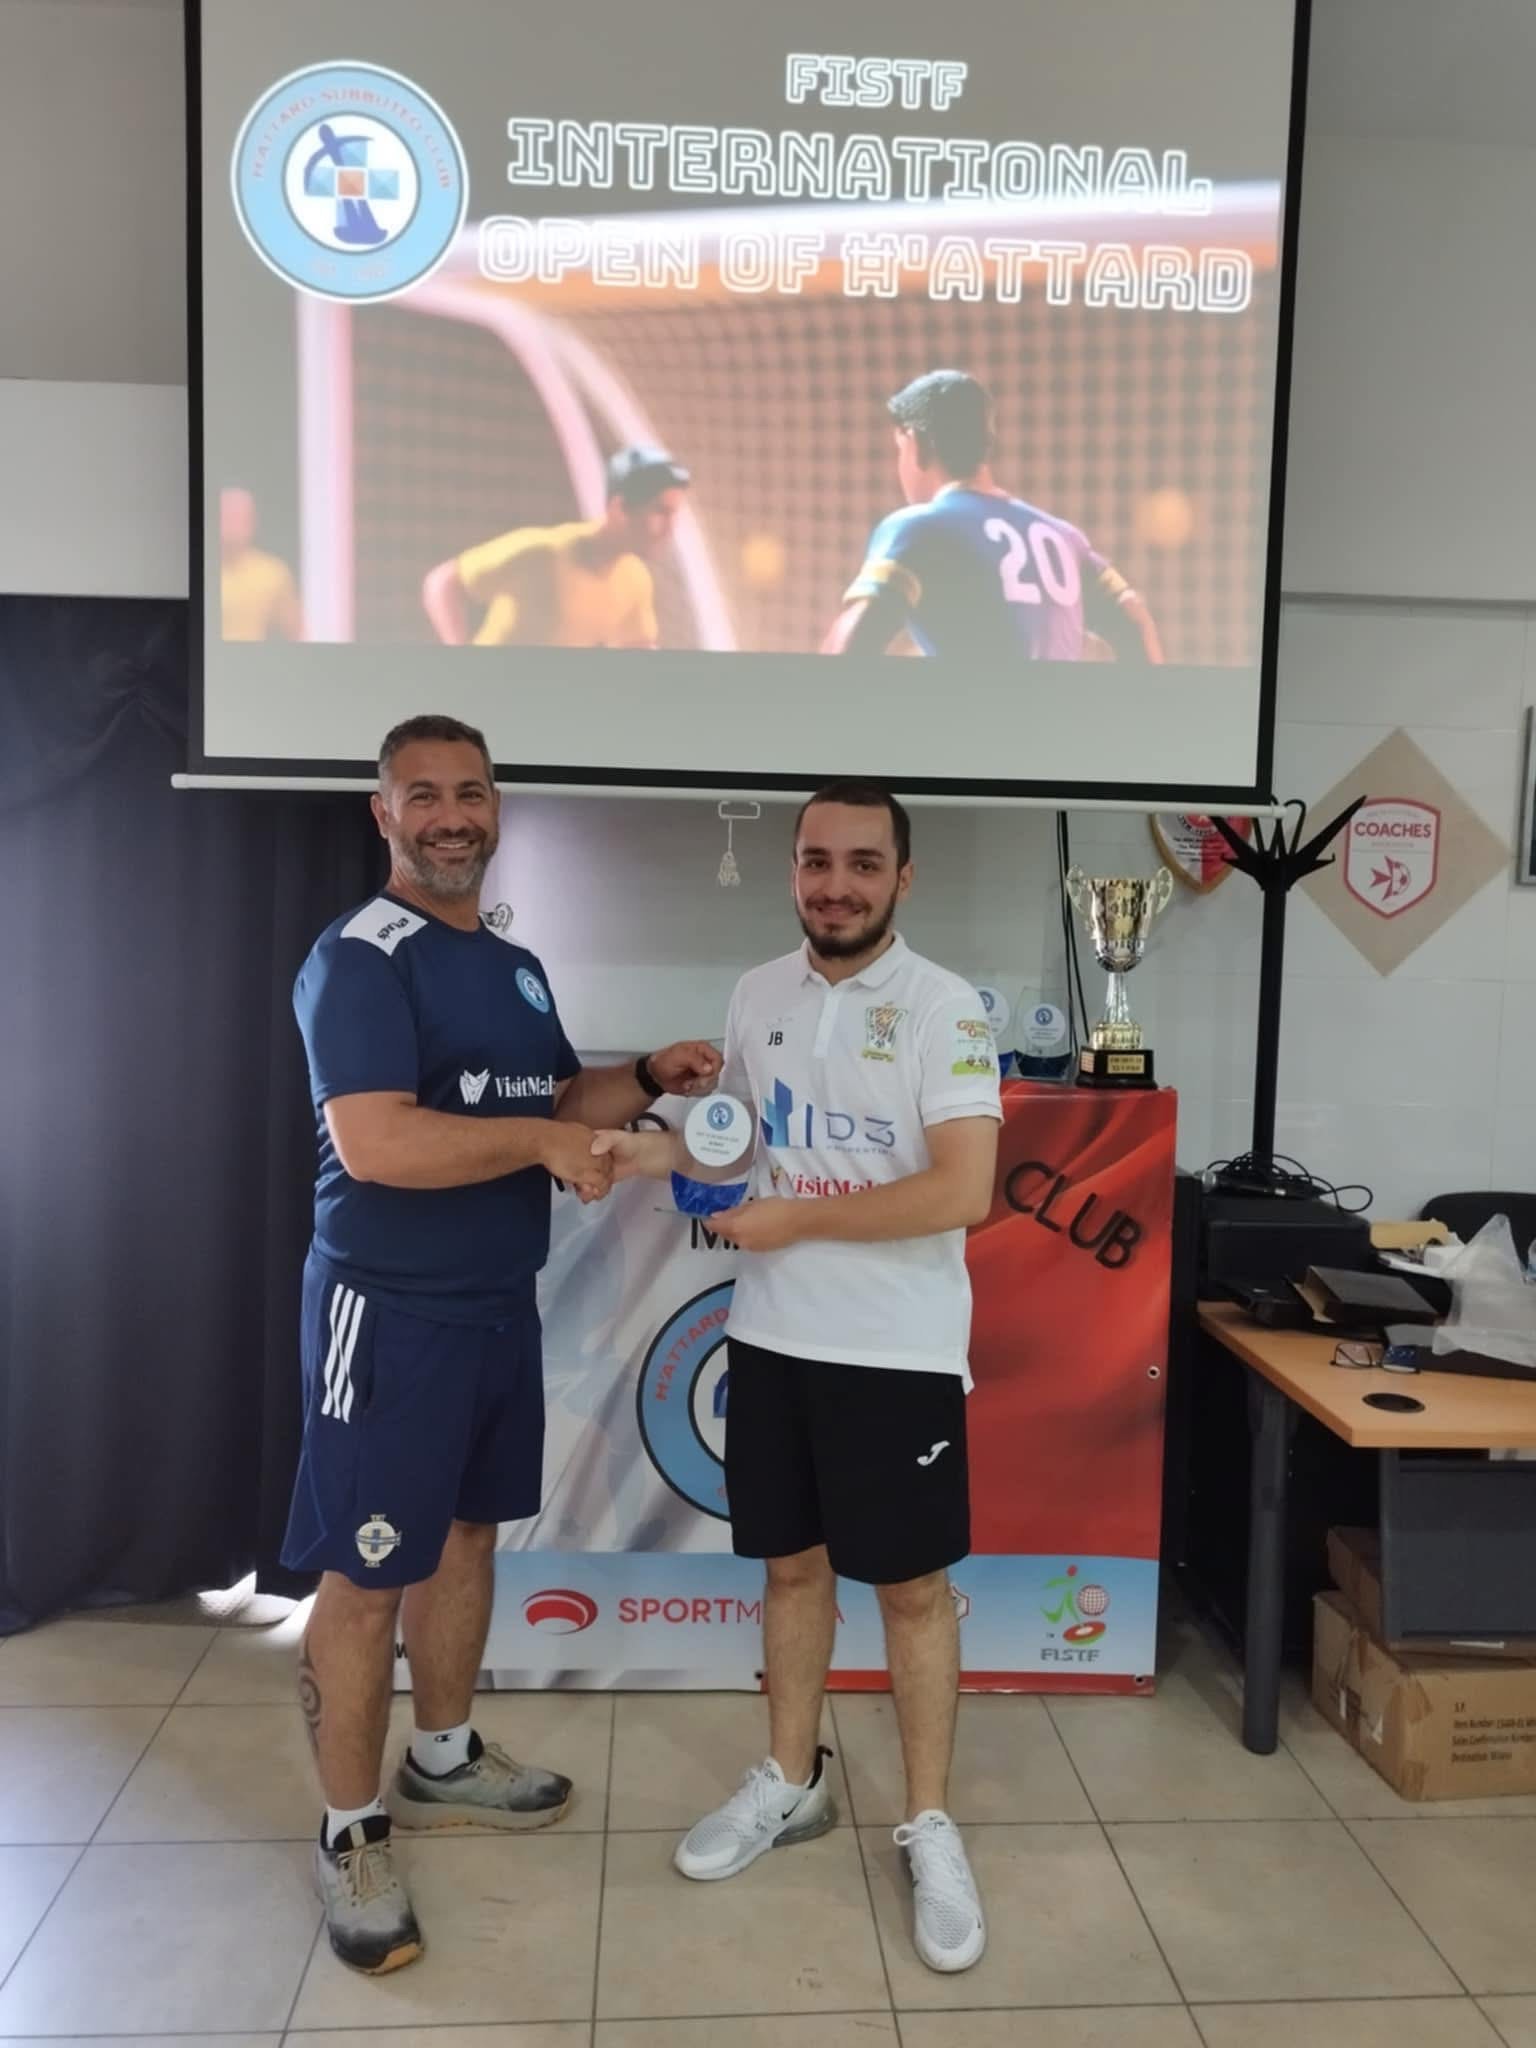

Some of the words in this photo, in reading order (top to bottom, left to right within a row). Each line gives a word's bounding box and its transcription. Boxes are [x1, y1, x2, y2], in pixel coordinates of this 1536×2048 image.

[786, 54, 967, 110] FISTF
[508, 117, 1212, 215] INTERNATIONAL
[478, 214, 700, 290] OPEN
[718, 229, 824, 295] OF
[984, 517, 1081, 608] 20
[1354, 821, 1432, 839] COACHES
[768, 1031, 784, 1046] JB
[1004, 1161, 1142, 1270] CLUB
[1040, 1647, 1101, 1662] FISTF
